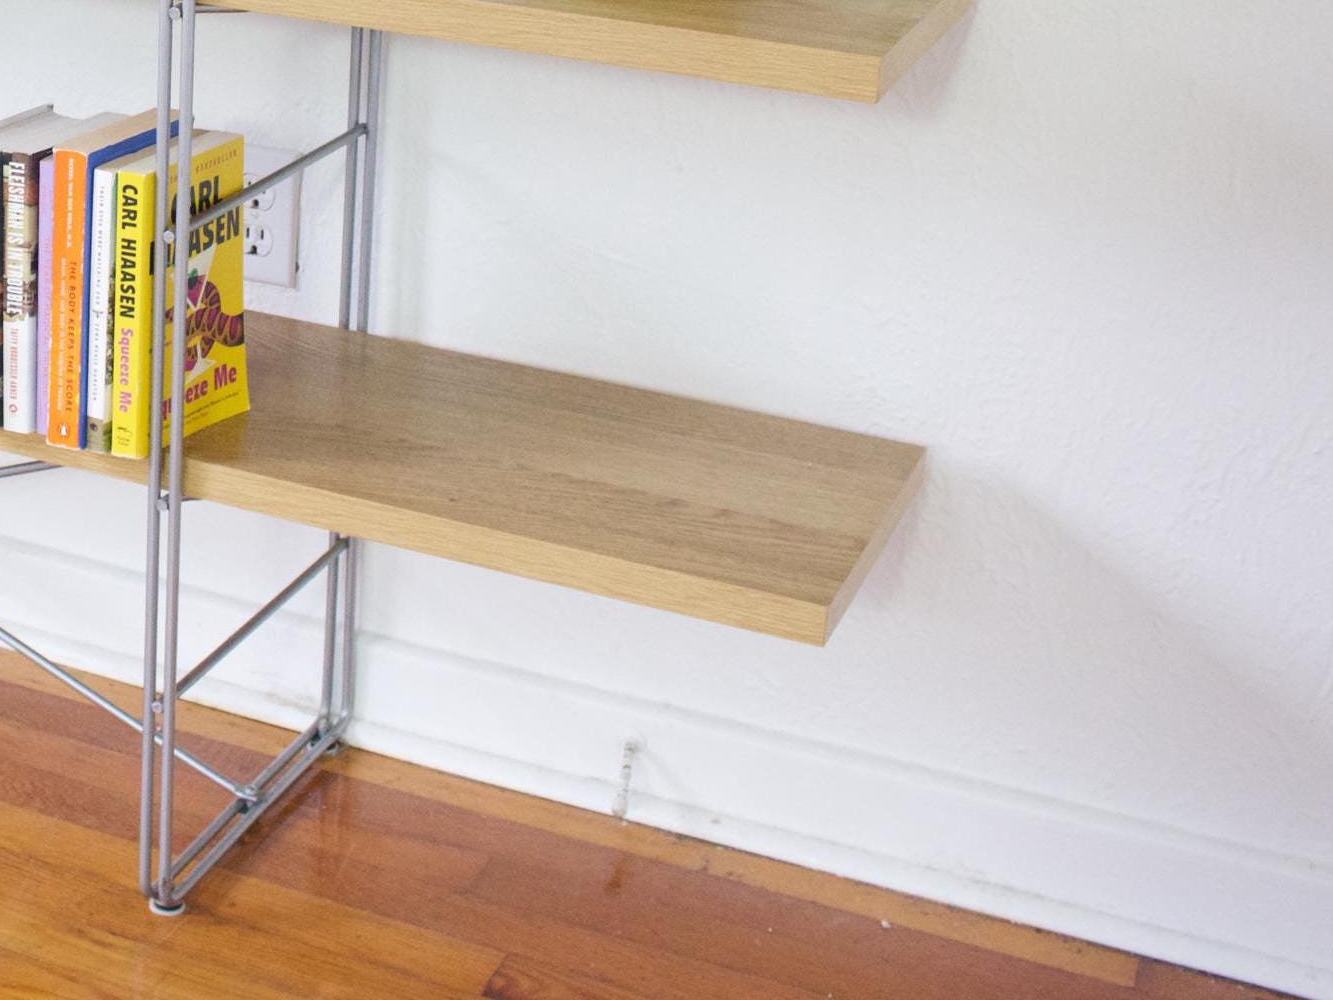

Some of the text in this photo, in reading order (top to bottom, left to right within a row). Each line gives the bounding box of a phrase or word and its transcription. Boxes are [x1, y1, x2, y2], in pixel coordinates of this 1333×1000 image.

[6, 161, 26, 316] FLEISHMAN IS IN TROUBLE
[119, 184, 139, 319] CARL HIAASEN
[69, 261, 77, 280] THE
[68, 285, 76, 313] BODY
[67, 318, 75, 350] KEEPS
[66, 354, 74, 373] THE
[118, 327, 134, 386] Squeeze
[214, 363, 237, 391] Me
[119, 391, 132, 413] Me
